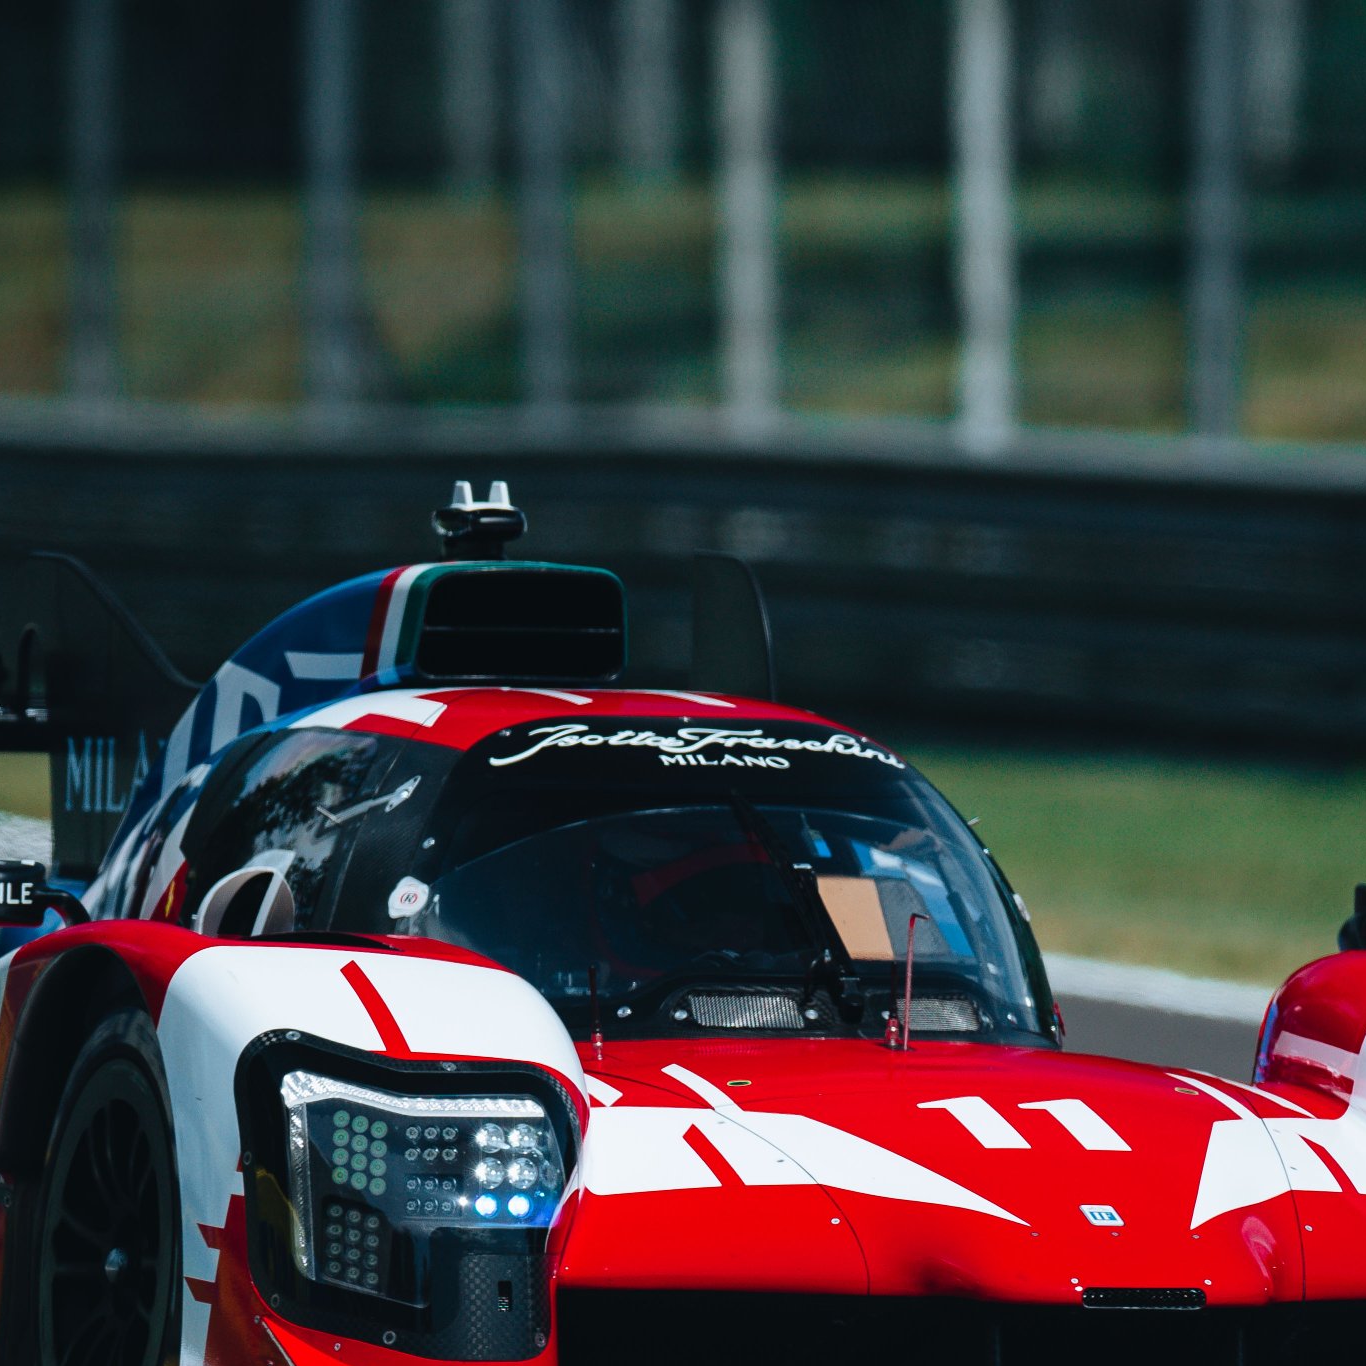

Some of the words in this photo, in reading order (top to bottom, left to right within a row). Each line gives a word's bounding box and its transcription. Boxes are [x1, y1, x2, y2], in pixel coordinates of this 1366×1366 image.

[66, 729, 166, 812] MILA
[490, 723, 684, 767] Isotta
[662, 727, 905, 769] Fraschini
[659, 754, 791, 769] MILANO
[917, 1096, 1133, 1151] 11
